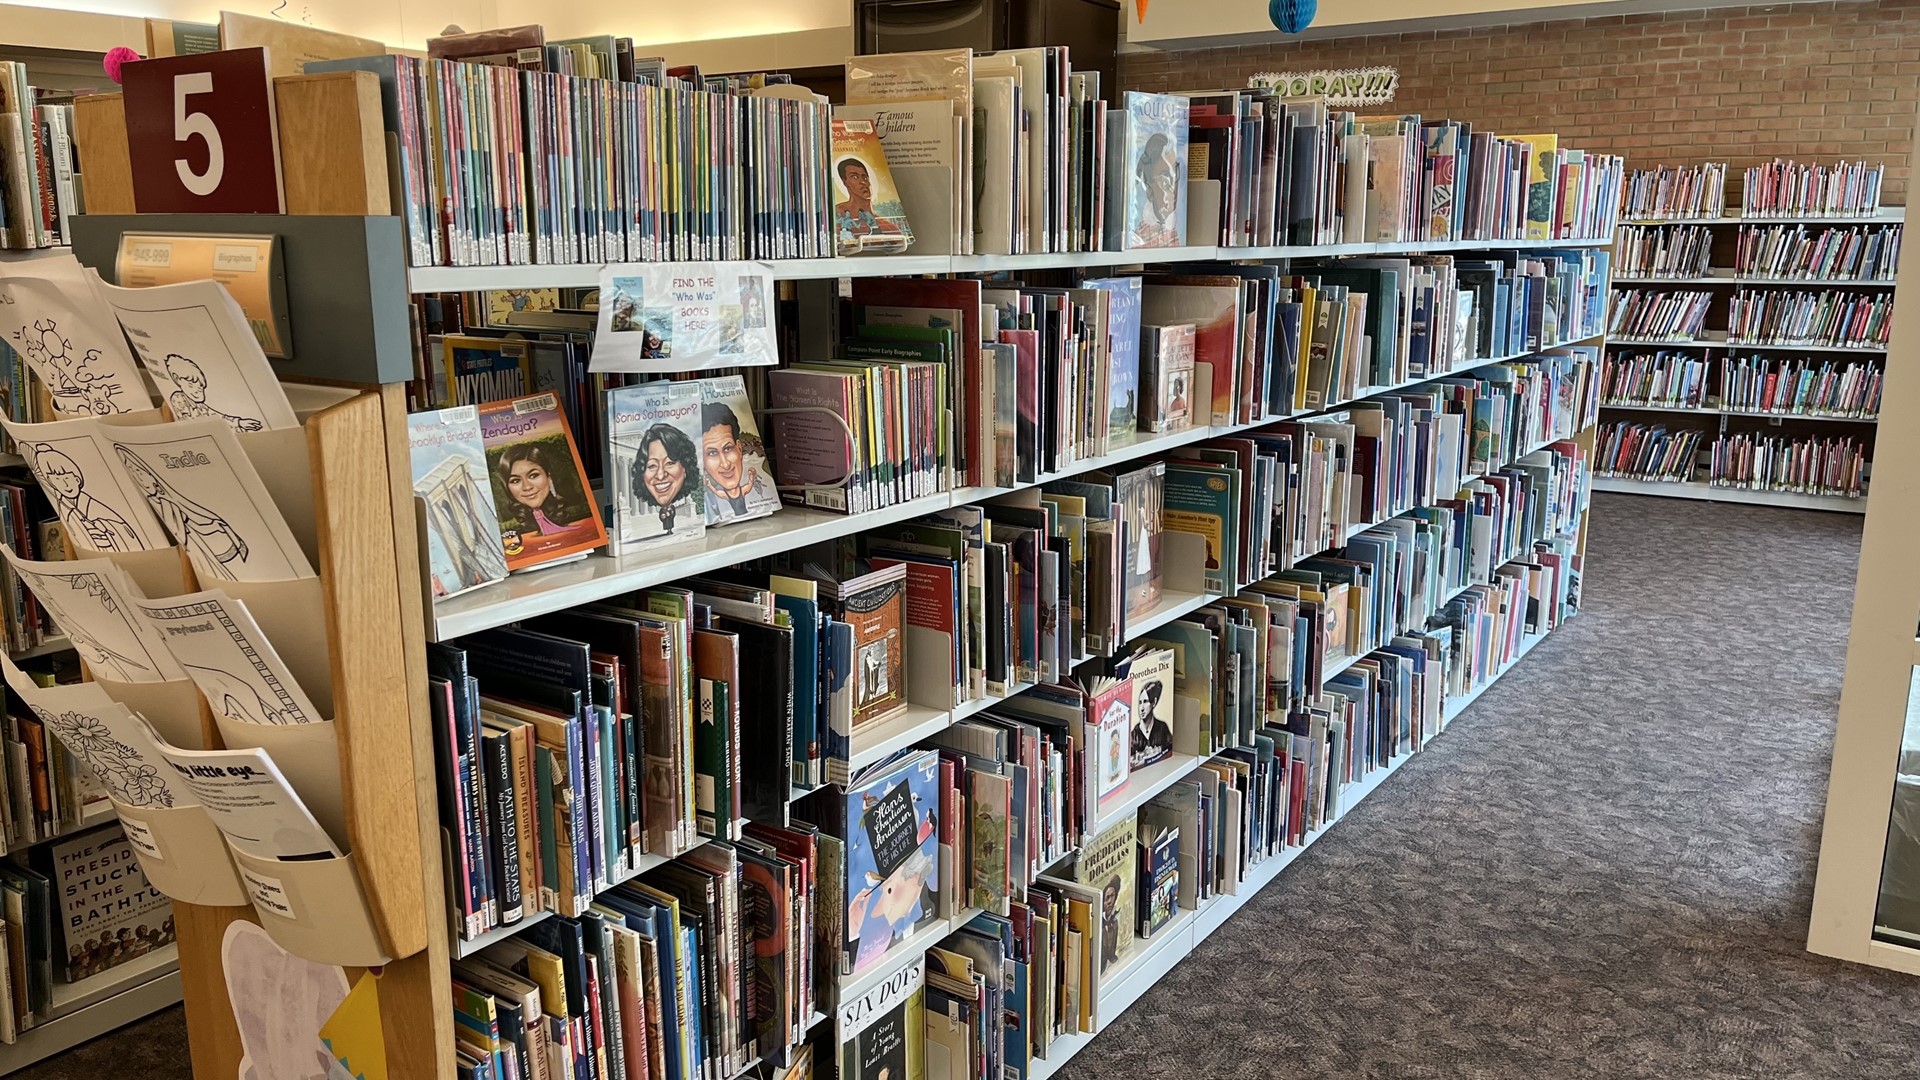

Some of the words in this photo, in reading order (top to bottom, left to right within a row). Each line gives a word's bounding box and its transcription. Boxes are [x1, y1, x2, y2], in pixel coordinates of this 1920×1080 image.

[875, 110, 914, 127] Famous
[174, 72, 224, 196] 5
[218, 253, 252, 263] Biographies
[672, 278, 695, 288] FIND
[698, 277, 714, 287] THE
[672, 292, 693, 301] "Who
[696, 291, 716, 301] Was"
[681, 307, 709, 317] BOOKS
[684, 321, 706, 330] HERE
[847, 346, 868, 354] Compass
[881, 348, 893, 356] Early
[894, 349, 922, 357] Biographies
[455, 366, 525, 407] WYOMING
[645, 398, 660, 408] Who
[662, 396, 670, 406] Is
[490, 414, 512, 424] Who
[616, 412, 640, 424] Sonia
[642, 404, 698, 420] Sotomayor?
[414, 422, 438, 433] Where
[482, 418, 538, 439] Zendaya?
[408, 434, 446, 449] Brooklyn
[446, 428, 477, 443] Bridge?
[158, 450, 211, 469] India
[1129, 667, 1158, 680] Dorothea
[1158, 661, 1170, 672] Dix
[733, 710, 741, 749] ROUNDS
[1104, 713, 1126, 732] Duration
[467, 734, 475, 762] STACEY
[189, 765, 226, 778] little
[498, 744, 508, 780] ACEVEDO
[517, 756, 527, 788] ISLAND
[589, 759, 597, 780] JOHN
[627, 752, 637, 791] Invincible
[469, 766, 478, 796] ABRAMS
[497, 792, 504, 801] My
[503, 788, 514, 820] PATH
[575, 793, 583, 813] JOHN
[590, 781, 599, 810] QUINCY
[497, 802, 506, 821] Journey
[520, 791, 531, 840] TREASURES
[872, 793, 904, 821] Hans
[506, 822, 516, 836] TO
[591, 811, 600, 839] ADAMS
[874, 803, 908, 834] Christian
[576, 815, 585, 844] ADAMS
[874, 811, 912, 850] Andersen
[507, 841, 518, 862] THE
[878, 849, 890, 862] THE
[890, 824, 913, 852] JOURNEY
[882, 856, 890, 868] OF
[890, 849, 900, 862] HIS
[900, 838, 911, 855] LIFE
[1085, 830, 1133, 872] FREDERICK
[60, 847, 94, 864] THE
[64, 850, 131, 881] PRESID
[1088, 847, 1130, 882] DOUGLASS
[66, 862, 140, 897] STUCK
[509, 865, 521, 902] STARS
[69, 898, 86, 911] IN
[92, 884, 124, 902] THE
[70, 888, 161, 928] BATHTU
[99, 914, 120, 925] ABOUT
[124, 908, 136, 916] THE
[676, 976, 682, 985] AS
[534, 1027, 542, 1045] THE
[872, 1032, 877, 1042] A
[878, 1021, 894, 1036] Story
[865, 1055, 881, 1068] Louis
[882, 1038, 902, 1056] Braille
[870, 1043, 877, 1056] of
[878, 1032, 895, 1047] Young
[536, 1047, 545, 1066] REAL
[618, 1058, 626, 1079] WOO
